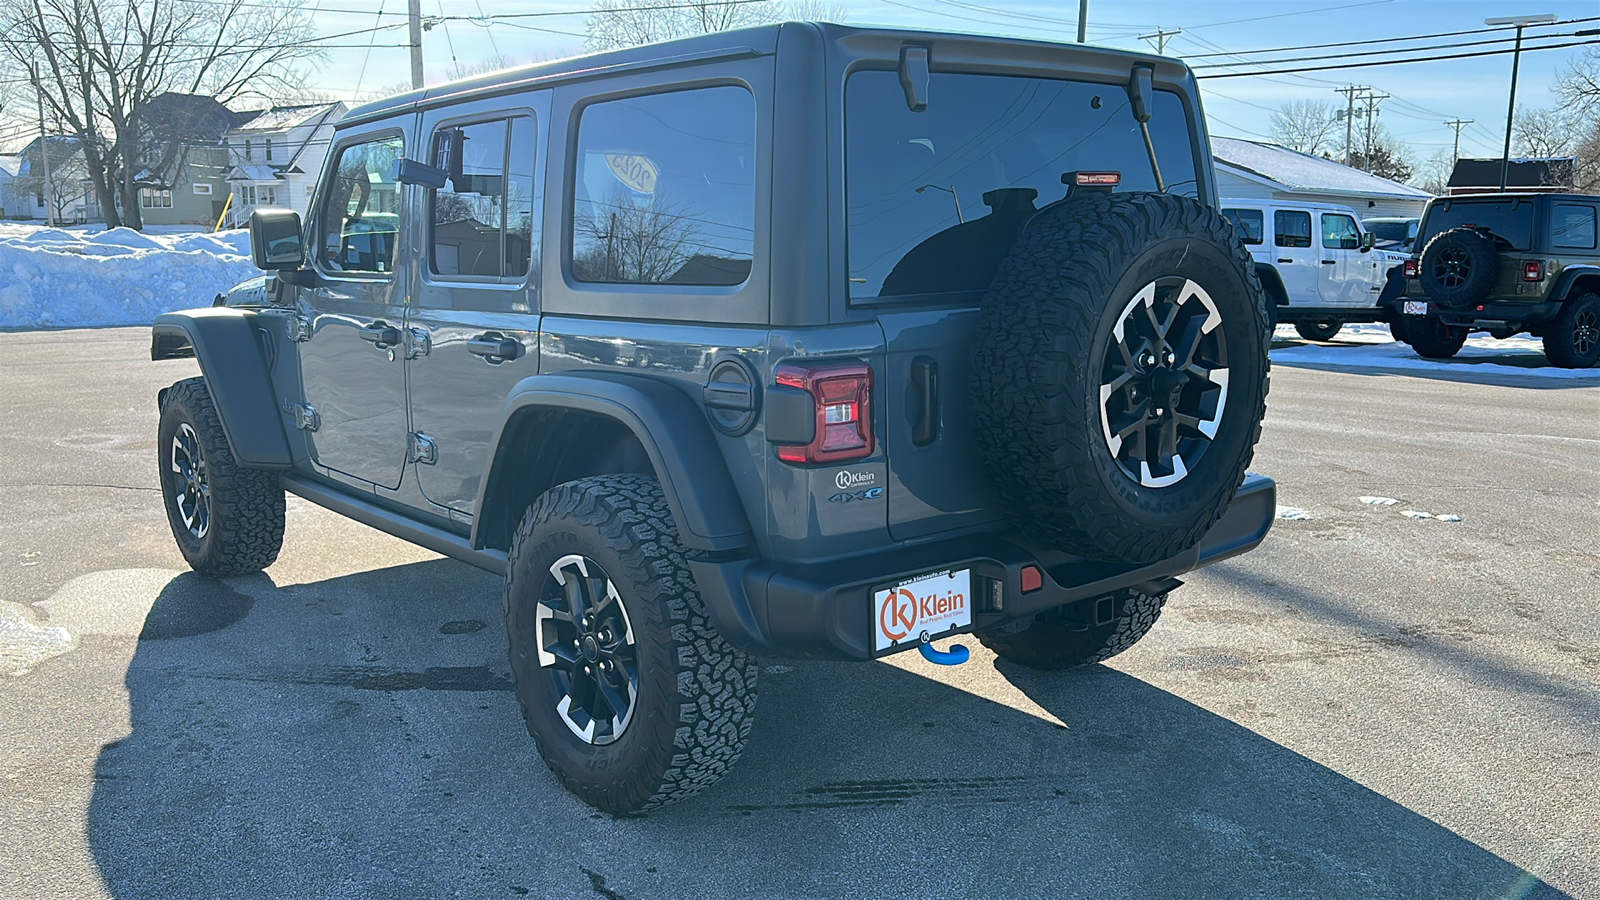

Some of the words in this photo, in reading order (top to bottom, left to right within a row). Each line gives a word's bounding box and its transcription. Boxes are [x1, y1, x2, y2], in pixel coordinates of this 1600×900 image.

[852, 471, 875, 483] Klein
[898, 569, 951, 586] www.kleinauto.com
[920, 590, 964, 619] Klein
